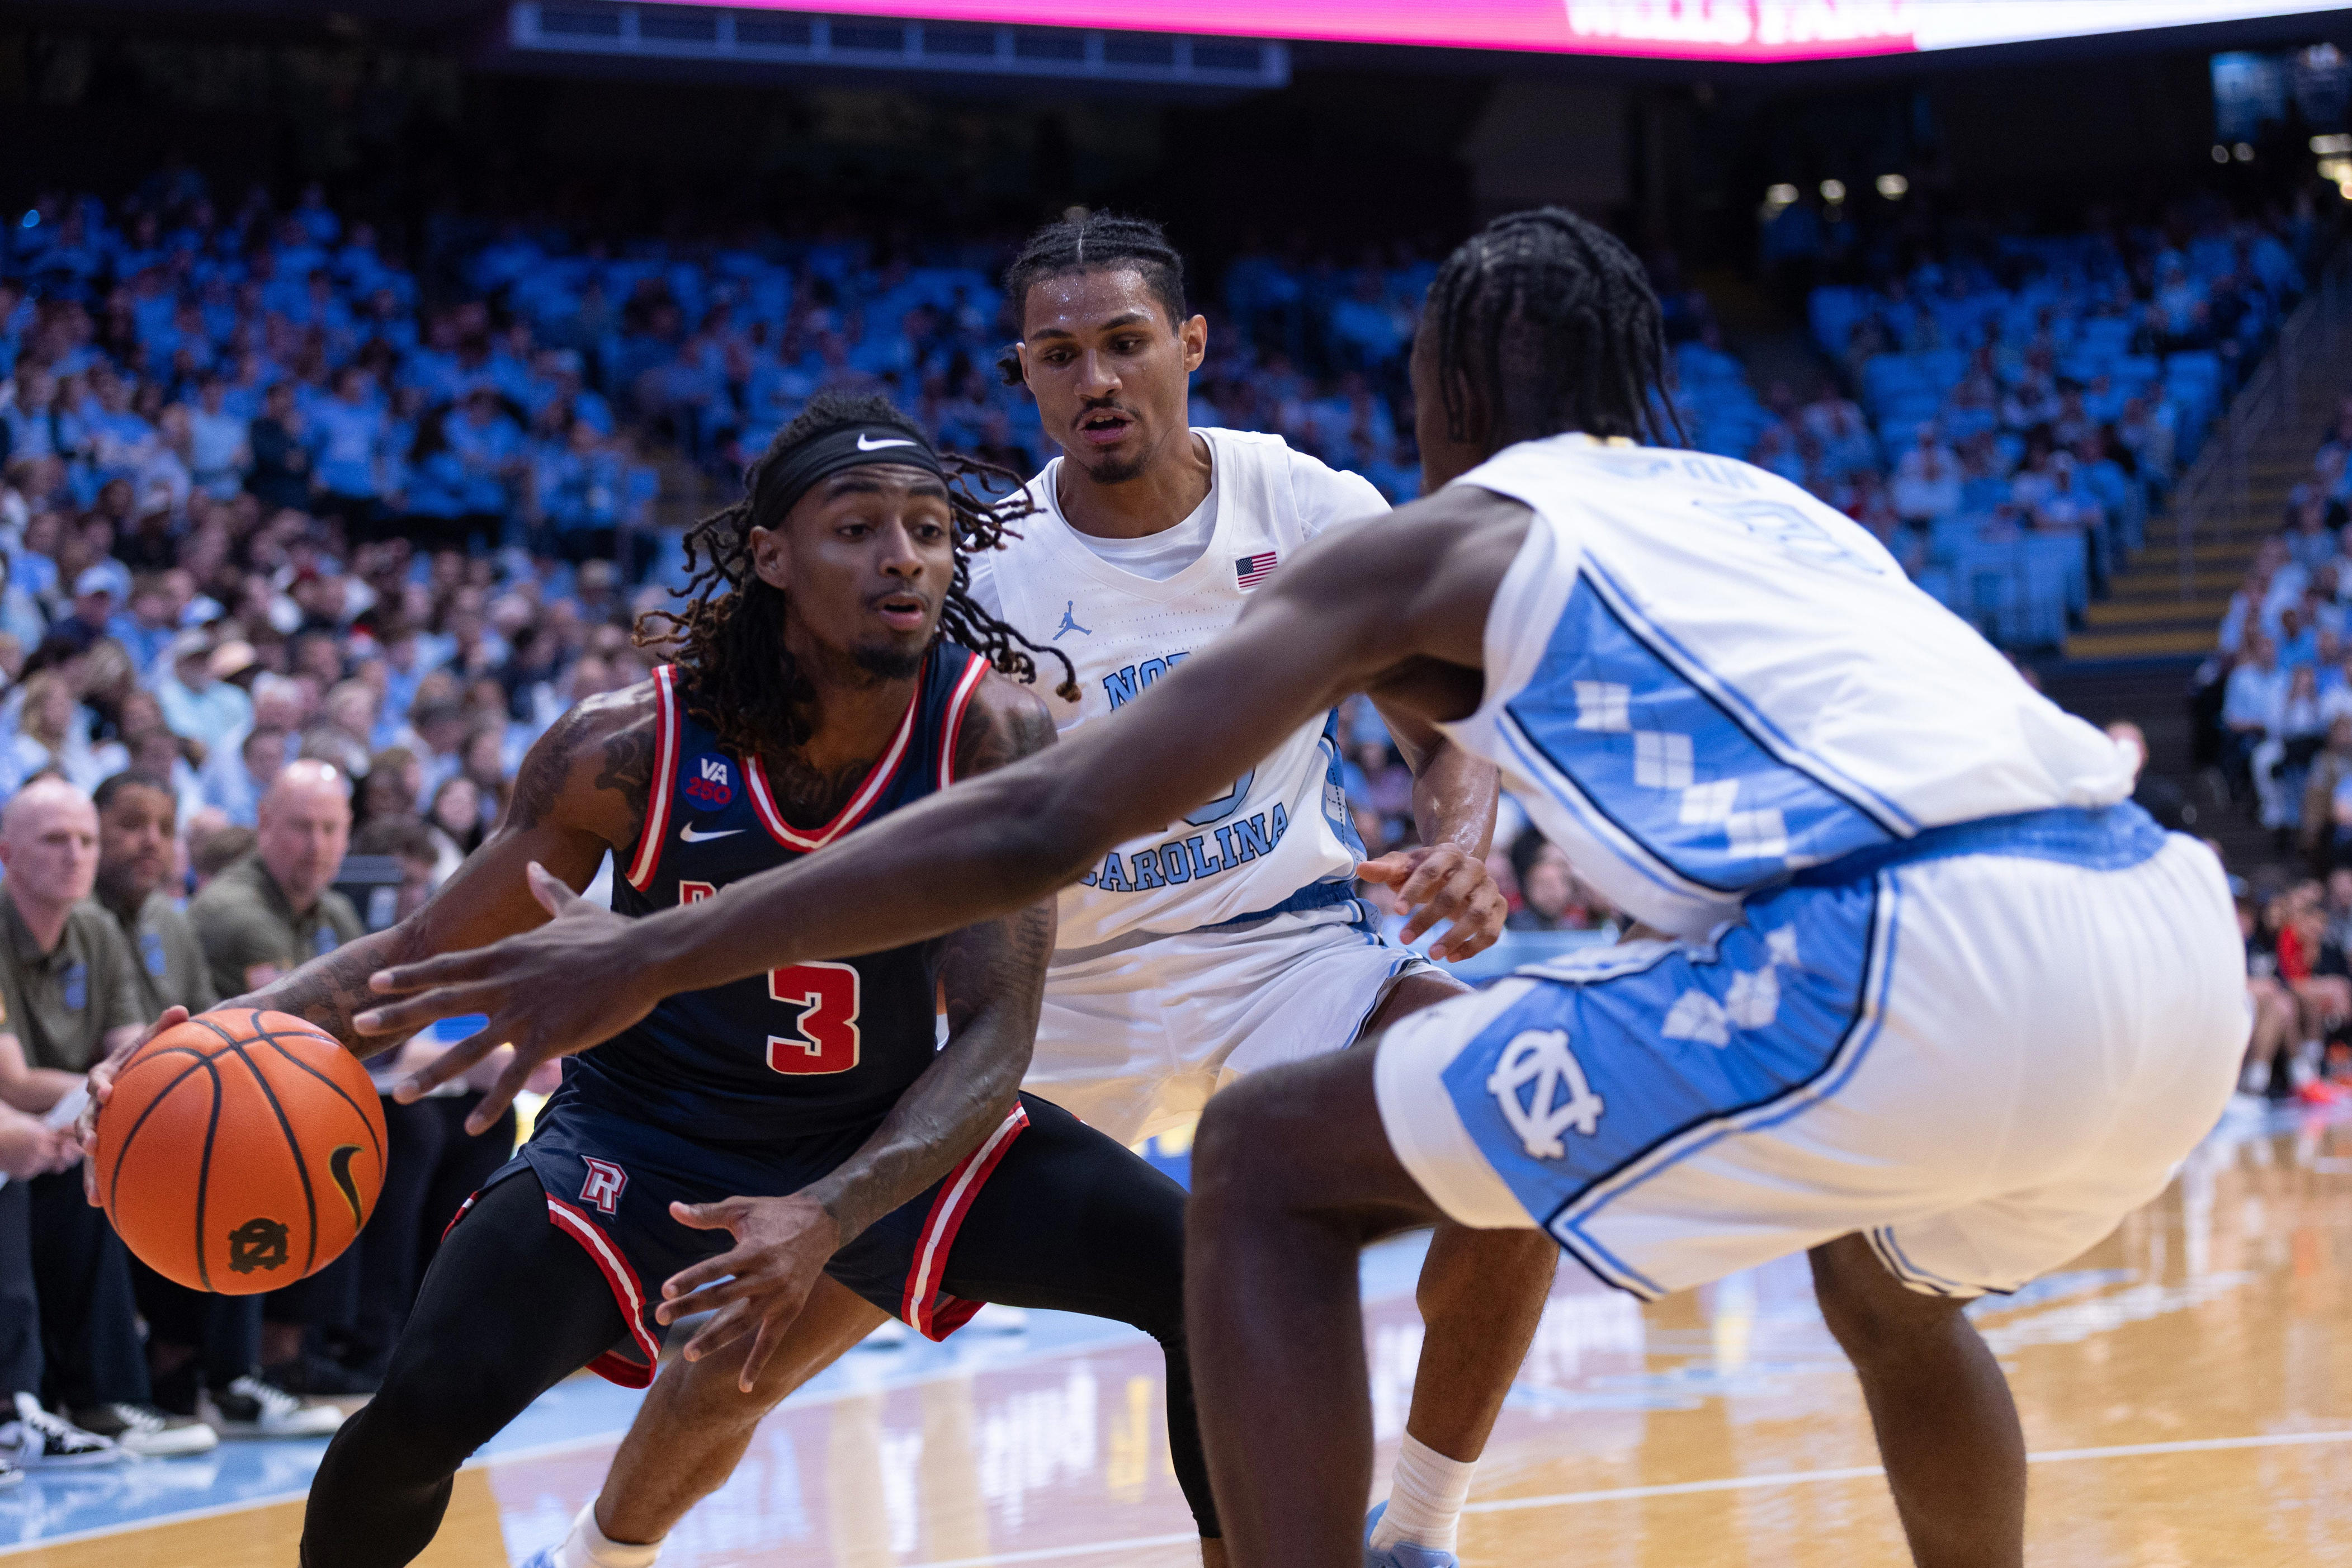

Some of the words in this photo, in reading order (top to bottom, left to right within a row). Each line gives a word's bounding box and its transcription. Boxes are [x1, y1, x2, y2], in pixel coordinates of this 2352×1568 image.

[686, 776, 732, 805] 250
[701, 757, 728, 786] VA
[766, 961, 861, 1075] 3
[578, 1155, 629, 1215] R
